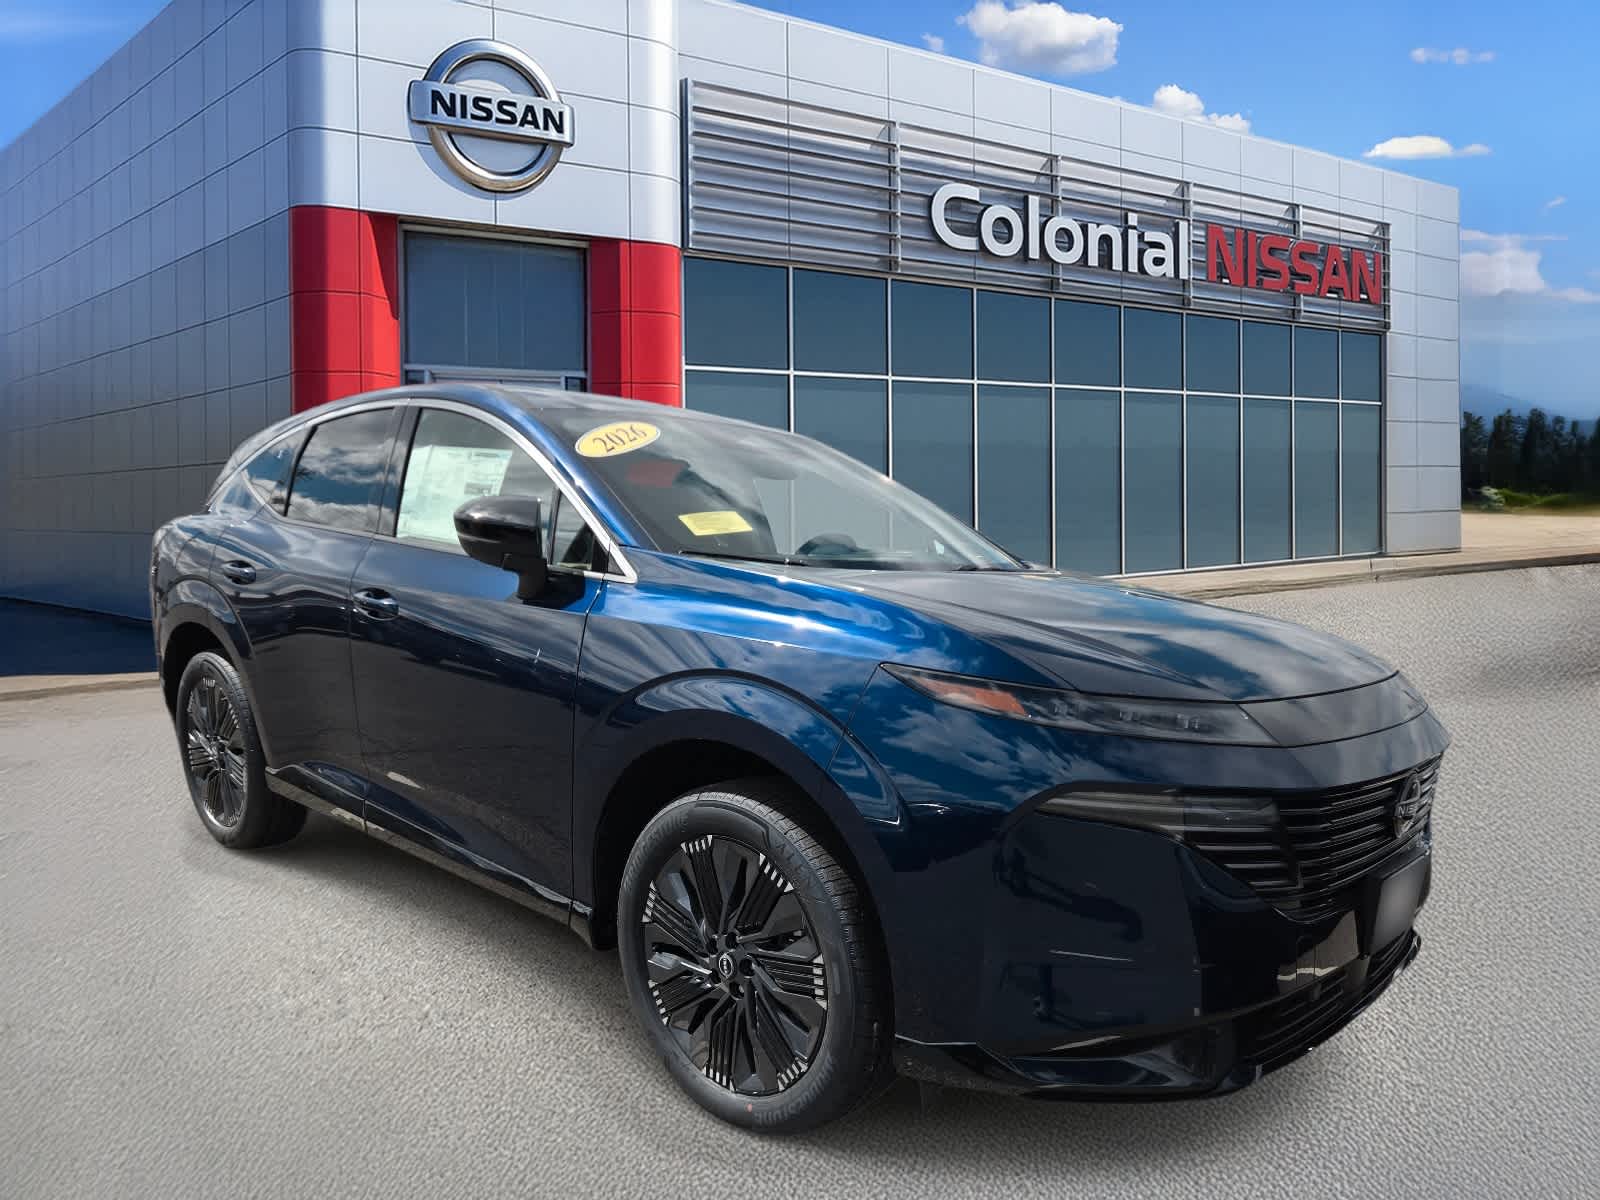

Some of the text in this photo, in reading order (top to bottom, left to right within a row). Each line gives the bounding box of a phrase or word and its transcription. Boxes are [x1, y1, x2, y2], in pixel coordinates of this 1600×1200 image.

[431, 90, 565, 134] NISSAN
[930, 182, 1381, 305] Colonial NISSAN
[592, 425, 647, 453] 2026
